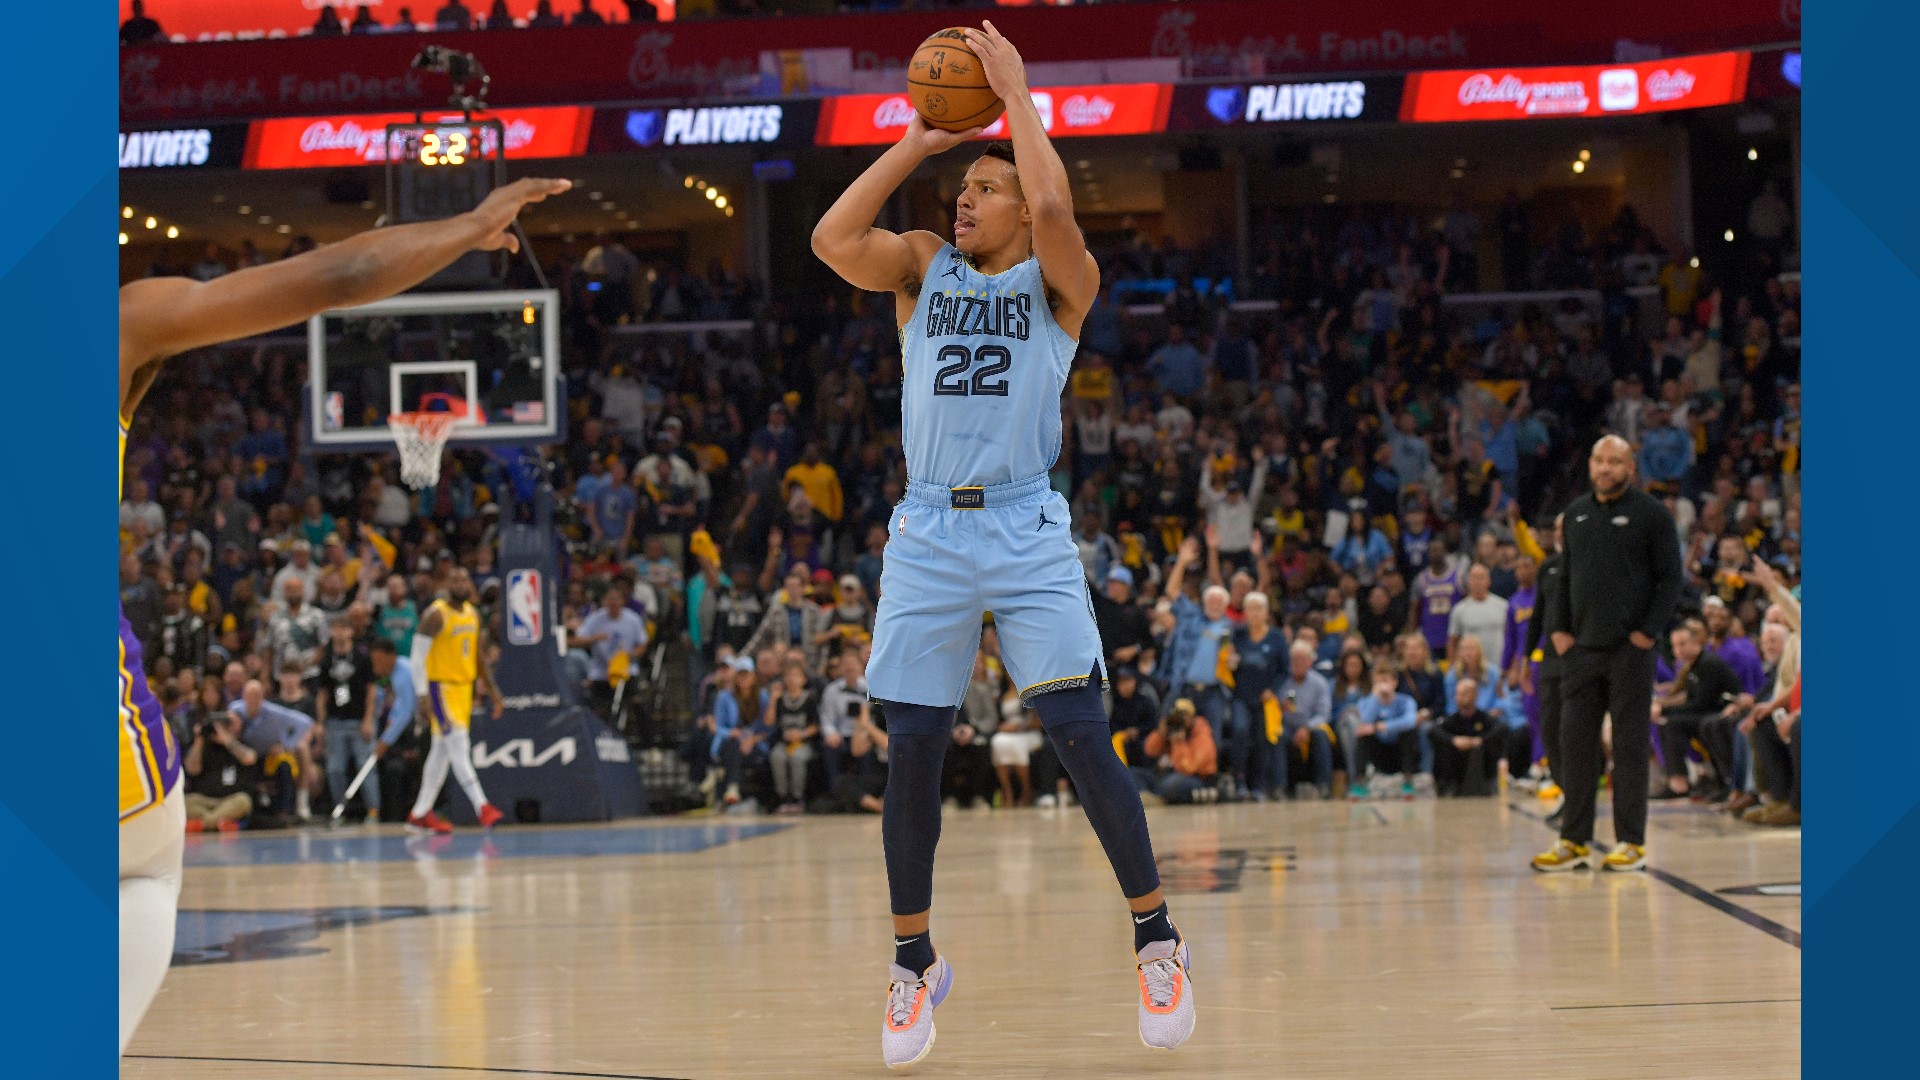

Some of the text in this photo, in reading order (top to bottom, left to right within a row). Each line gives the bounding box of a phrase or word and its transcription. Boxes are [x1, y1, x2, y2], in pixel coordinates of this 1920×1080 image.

[1246, 81, 1366, 122] PLAYOFFS
[1457, 73, 1530, 109] Bally
[663, 105, 783, 145] PLAYOFFS
[420, 132, 467, 166] 2.2
[926, 290, 1032, 341] GRIZZLIES
[933, 344, 1012, 397] 22
[471, 736, 577, 769] KIA
